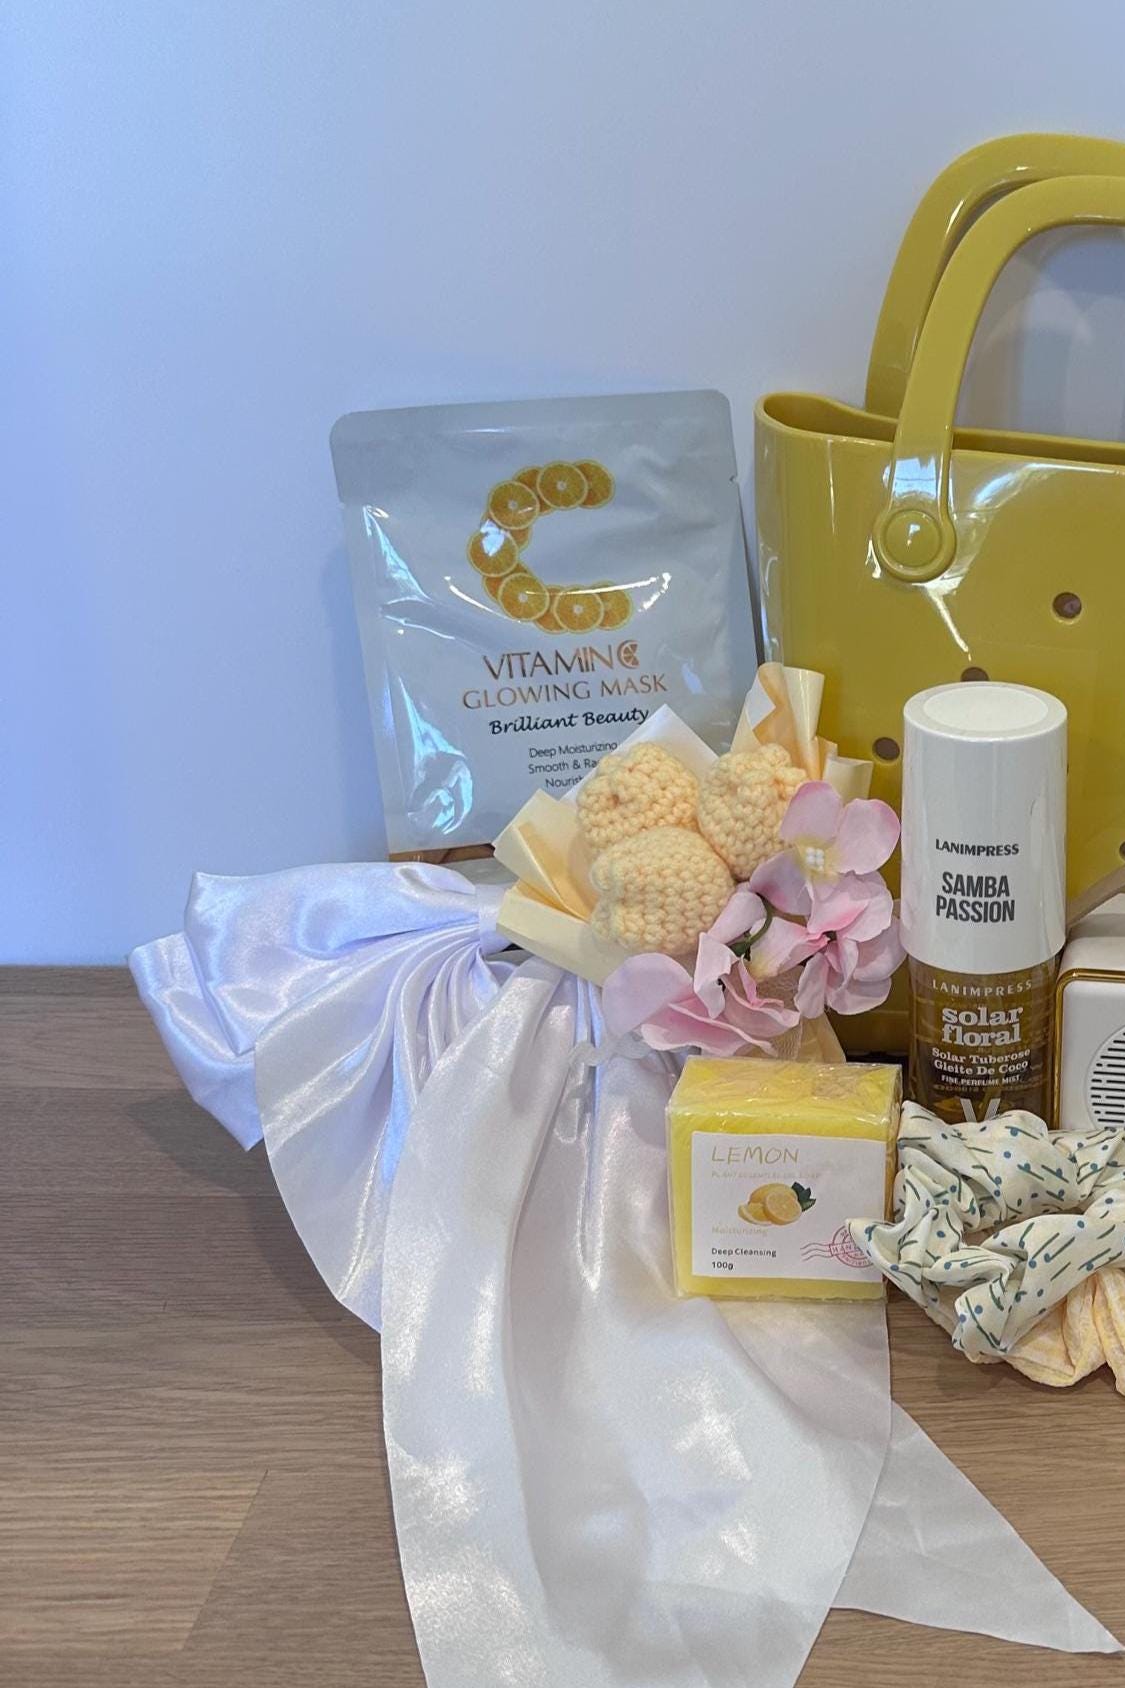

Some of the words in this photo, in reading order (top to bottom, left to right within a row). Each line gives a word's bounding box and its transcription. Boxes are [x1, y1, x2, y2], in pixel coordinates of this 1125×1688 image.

[483, 644, 614, 680] VITAMIN
[463, 680, 591, 710] GLOWING
[601, 673, 669, 698] MASK
[489, 712, 579, 735] Brilliant
[582, 706, 649, 725] Beauty
[529, 746, 557, 759] Deep
[528, 762, 570, 775] Smooth
[572, 758, 581, 770] &
[935, 838, 1020, 857] LANIMPRESS
[941, 871, 1011, 898] SAMBA
[935, 894, 1016, 923] PASSION
[932, 979, 1033, 997] LANIMPRESS
[941, 1006, 1024, 1027] solar
[941, 1023, 1022, 1047] floral
[931, 1047, 967, 1064] Solar
[968, 1048, 1031, 1065] Tuberose
[976, 1065, 996, 1076] De
[999, 1060, 1029, 1075] Coco
[710, 1145, 800, 1166] LEMON
[711, 1247, 734, 1257] Deep
[735, 1247, 777, 1258] Cleansing
[711, 1261, 734, 1271] 100g
